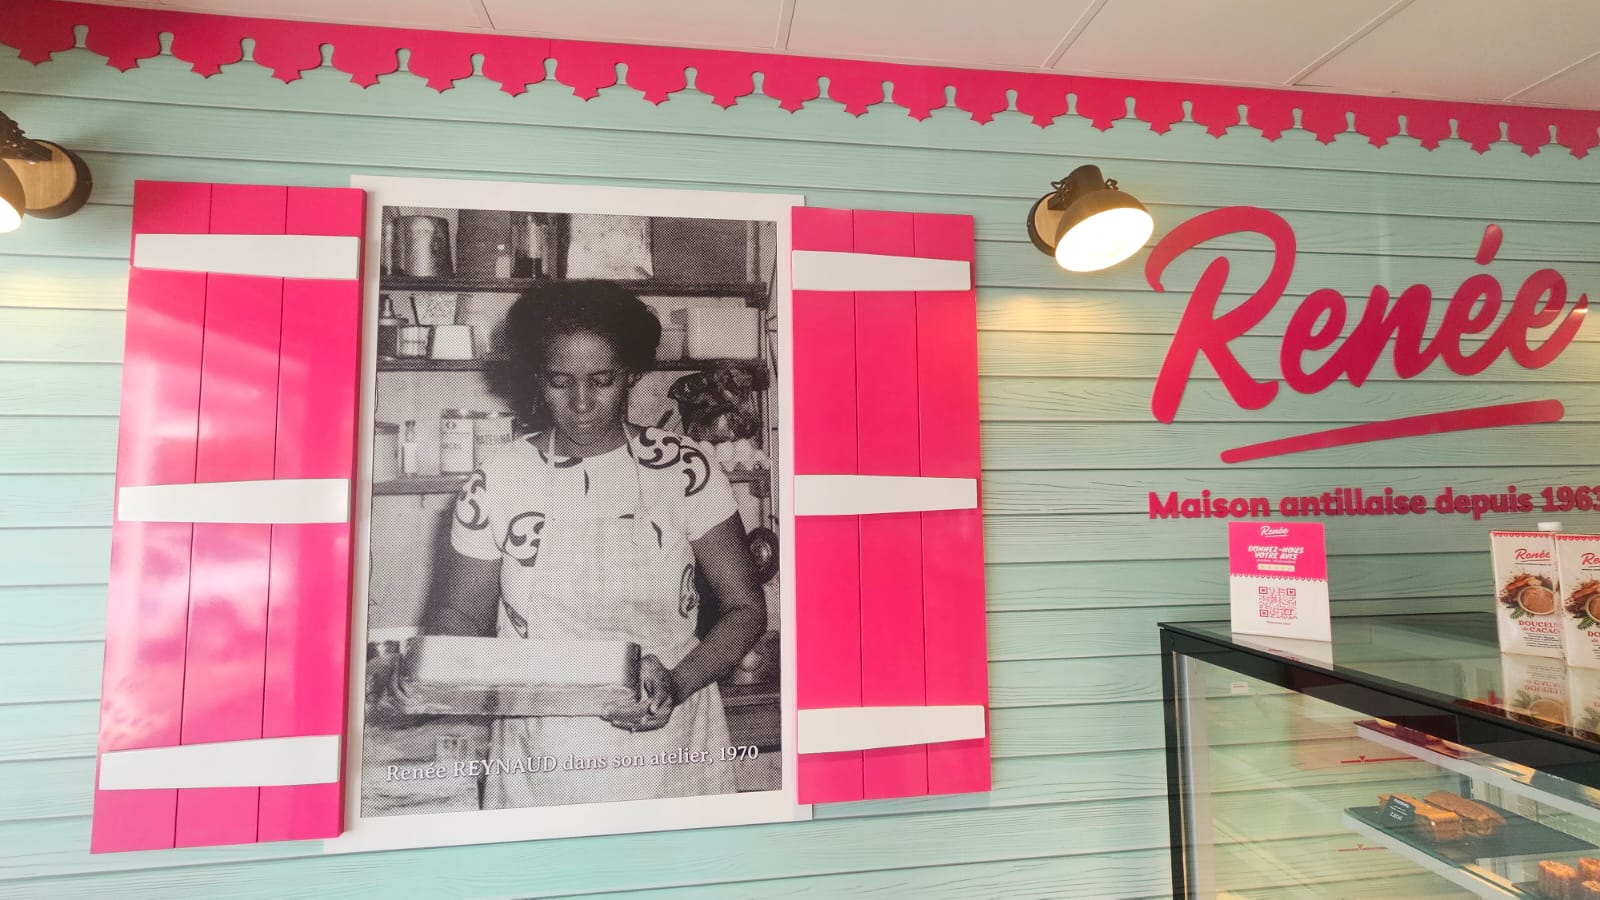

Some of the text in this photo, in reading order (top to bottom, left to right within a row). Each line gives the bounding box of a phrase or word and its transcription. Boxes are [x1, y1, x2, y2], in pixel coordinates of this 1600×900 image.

[1145, 206, 1589, 425] Renée
[1149, 485, 1600, 520] Maison antillaise depuis 1963
[1260, 525, 1289, 536] Renée
[1248, 545, 1304, 554] DONNEZ-NOUS
[1515, 548, 1551, 560] Renée
[386, 745, 759, 781] Renée REYNAUD dans son atelier, 1970
